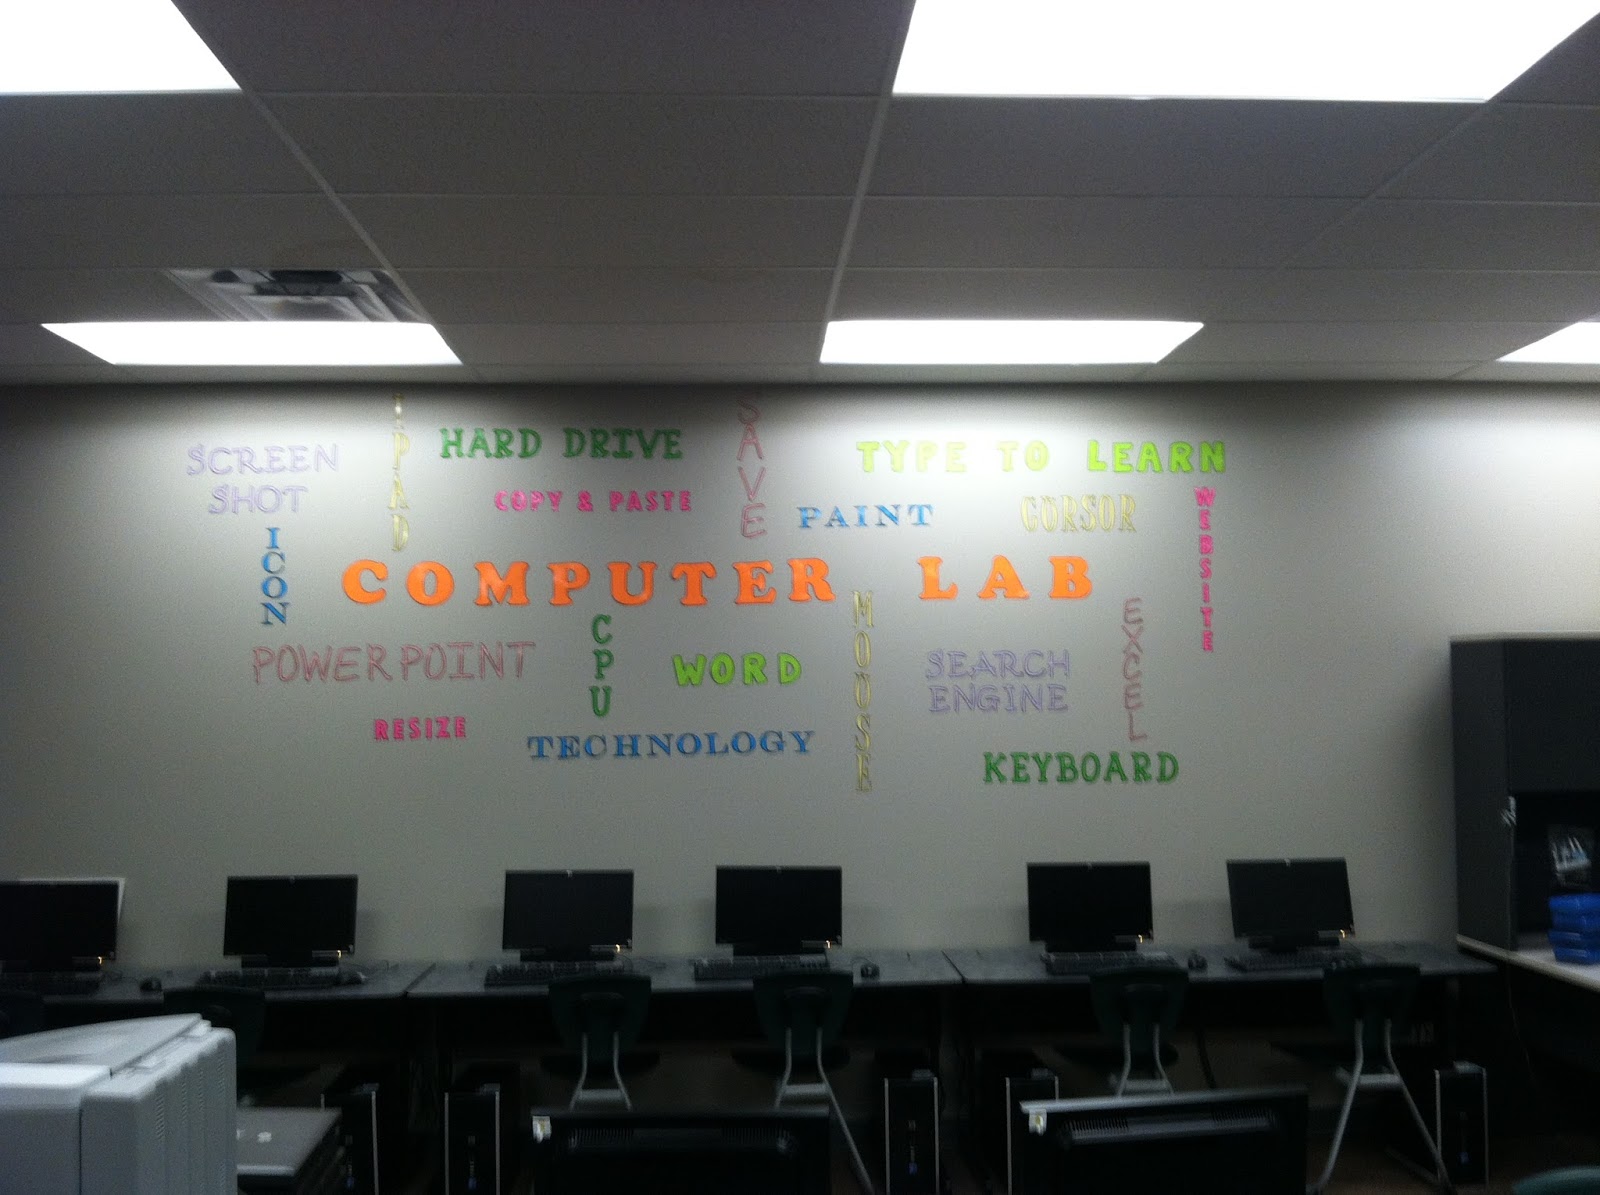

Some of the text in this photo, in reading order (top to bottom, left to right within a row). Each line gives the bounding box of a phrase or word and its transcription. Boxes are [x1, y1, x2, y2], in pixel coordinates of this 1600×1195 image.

[186, 443, 339, 477] SCREEN
[439, 427, 683, 459] HARD DRIVE
[856, 439, 1226, 473] TYPE TO LEARN
[736, 392, 768, 538] SAVE
[208, 484, 308, 515] SHOT
[494, 490, 692, 512] COPY & PASTE
[797, 504, 934, 528] PAINT
[261, 527, 289, 626] ICON
[342, 554, 1093, 606] COMPUTER LAB
[1193, 486, 1216, 653] WEBSITE
[589, 613, 615, 718] CPU
[672, 652, 803, 687] WORD
[924, 648, 1072, 679] SEARCH
[1121, 597, 1148, 742] EXCEL
[929, 684, 1069, 714] ENGINE
[373, 716, 467, 742] RESIZE
[527, 730, 815, 760] TECHNOLOGY
[984, 750, 1180, 784] KEYBOARD
